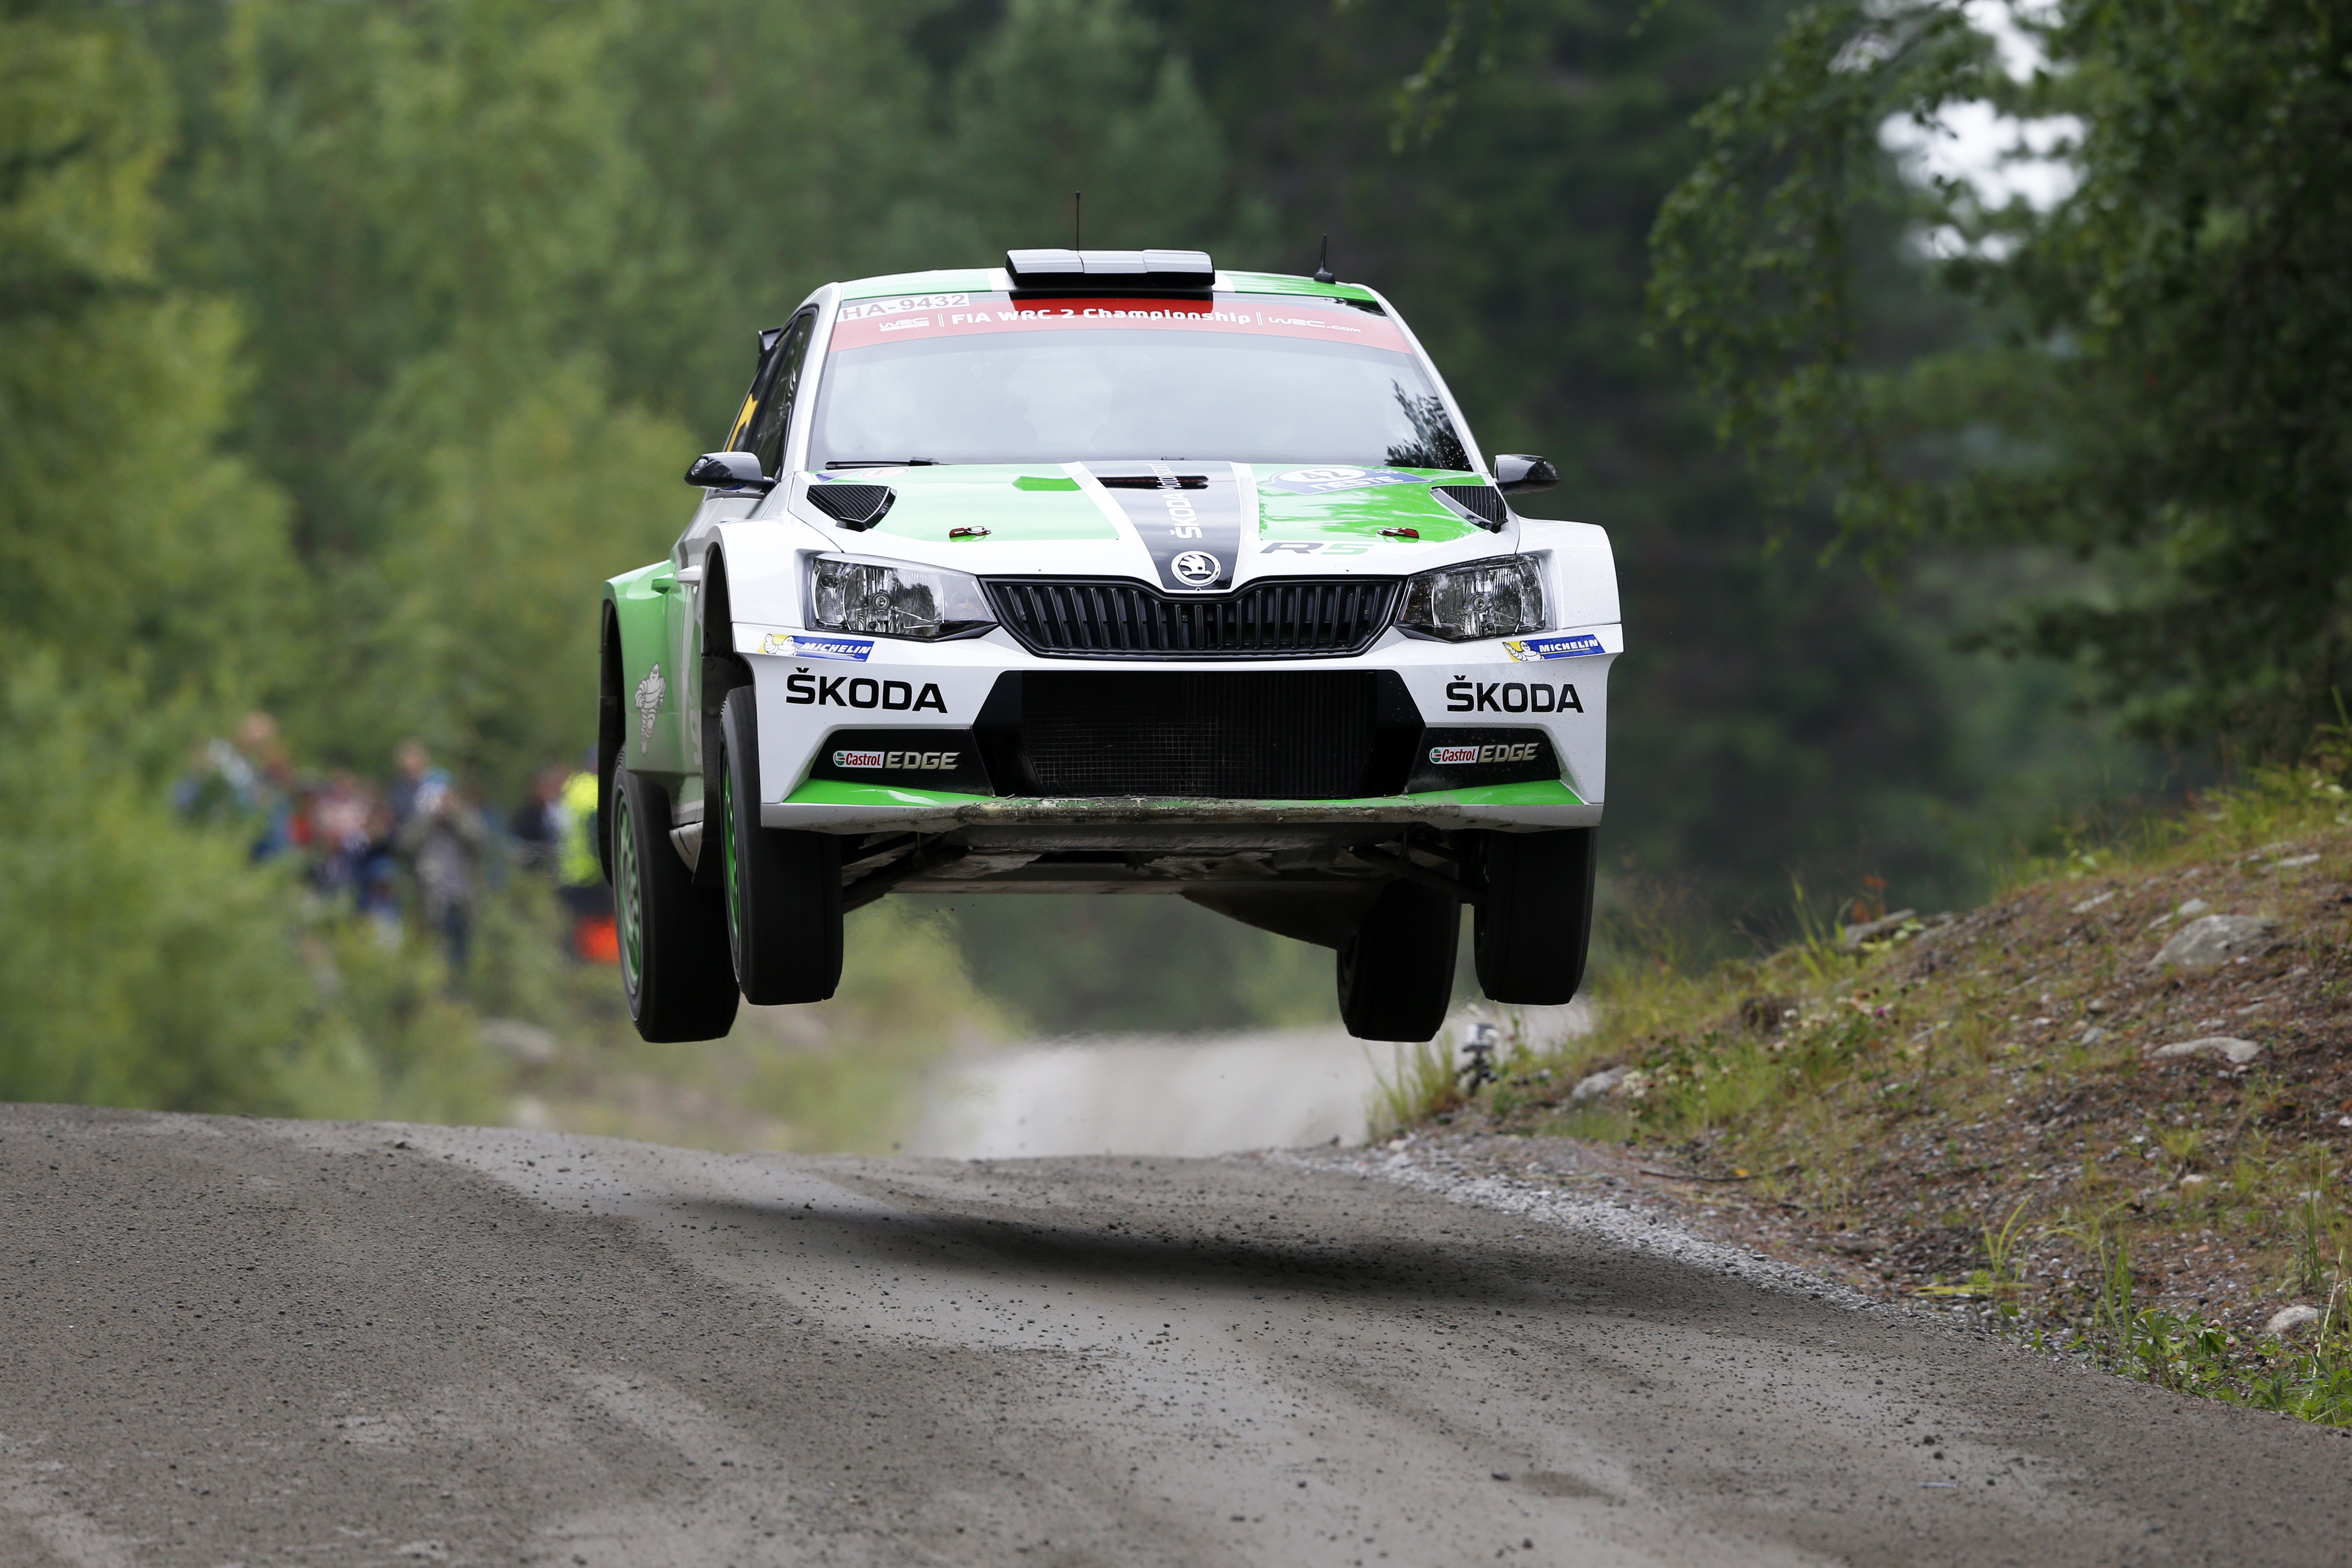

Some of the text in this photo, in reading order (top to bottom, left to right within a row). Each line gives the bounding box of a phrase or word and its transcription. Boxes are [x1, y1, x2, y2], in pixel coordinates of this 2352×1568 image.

[843, 294, 966, 319] HA-9432
[951, 313, 992, 324] FIA
[997, 309, 1053, 321] WRC
[1060, 309, 1075, 319] 2
[1083, 309, 1251, 325] Championship
[1300, 470, 1352, 480] 42
[1145, 463, 1203, 539] ŠKODA Motorsport
[1259, 542, 1375, 555] R5
[801, 642, 871, 654] MICHELIN
[1539, 639, 1598, 652] MICHELIN
[786, 667, 948, 713] ŠKODA
[1446, 675, 1584, 713] ŠKODA
[845, 751, 961, 769] Castrol EDGE
[1441, 743, 1540, 763] Castrol EDGE
